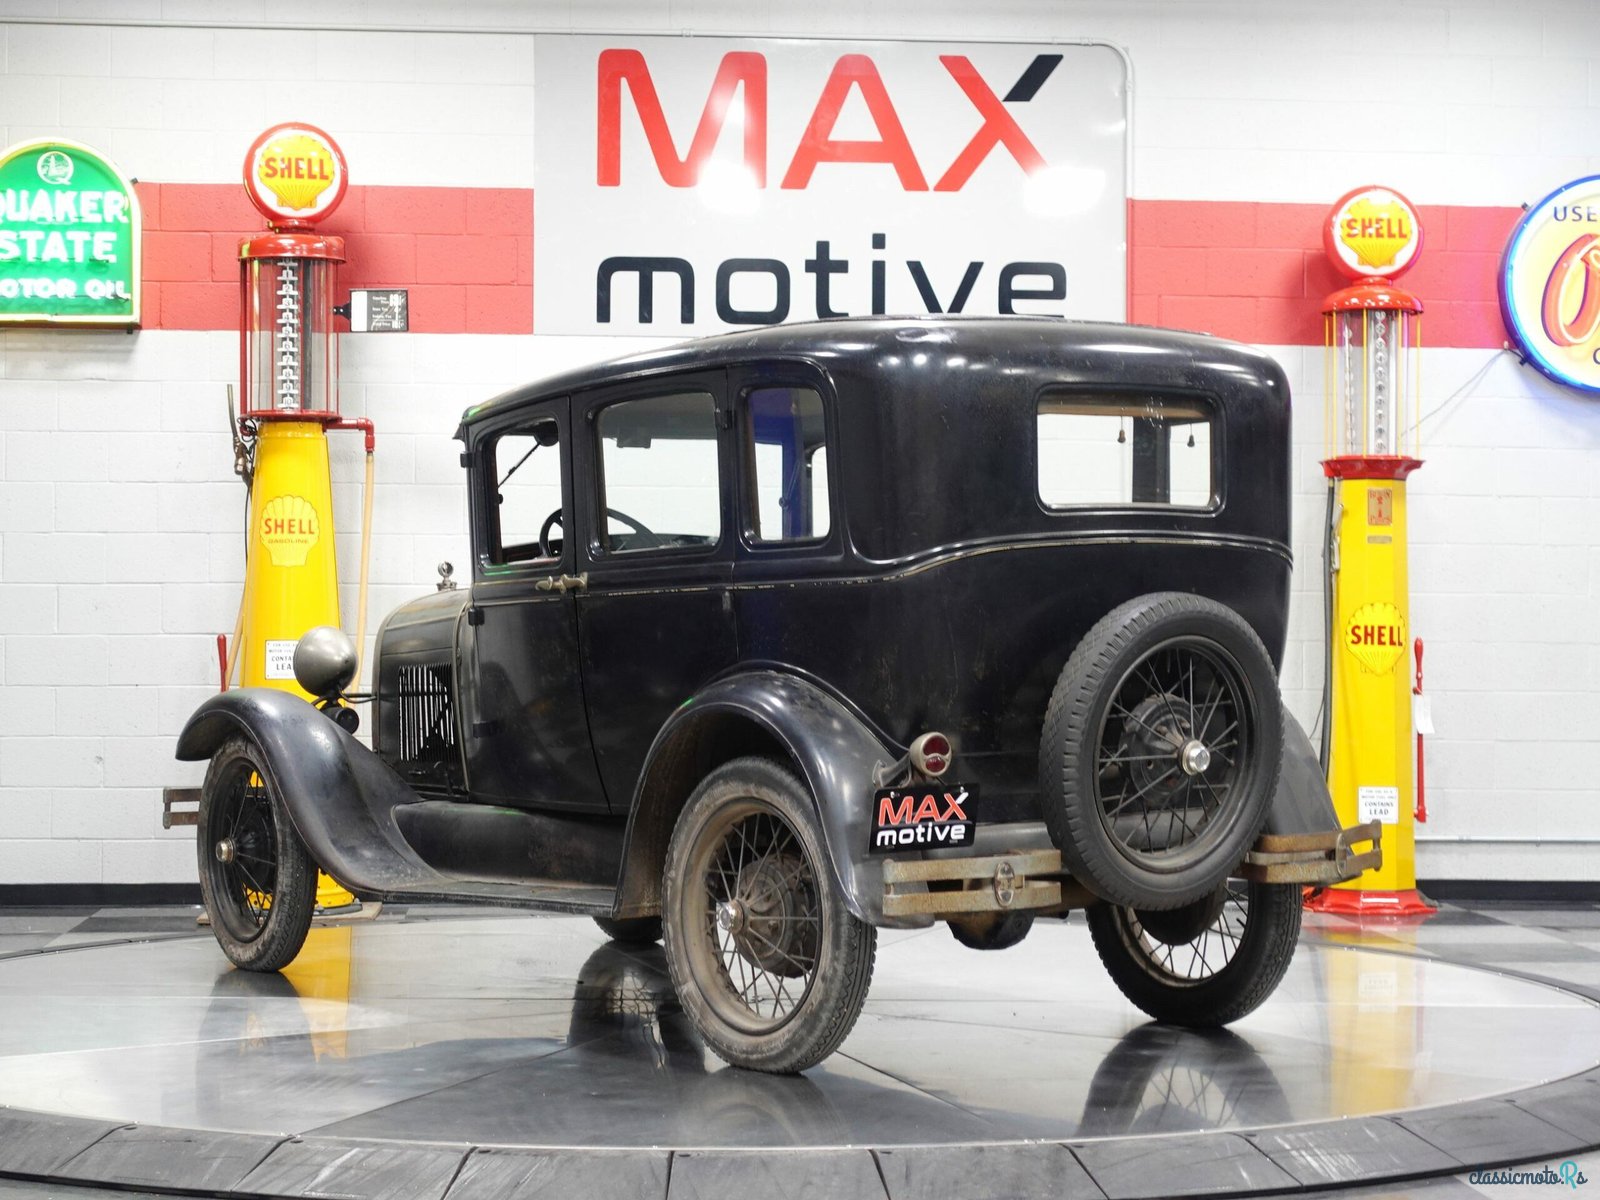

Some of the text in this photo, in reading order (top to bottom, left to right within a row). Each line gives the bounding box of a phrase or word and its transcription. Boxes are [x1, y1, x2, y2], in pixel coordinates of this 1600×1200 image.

[597, 49, 1064, 192] MAX
[264, 157, 330, 180] SHELL
[0, 188, 129, 223] UAKER
[1553, 206, 1598, 222] USE
[1346, 217, 1408, 239] SHELL
[0, 230, 117, 263] STATE
[0, 277, 131, 300] OTOR OIL
[596, 232, 1067, 325] motive
[264, 518, 315, 535] SHELL
[1350, 625, 1404, 647] SHELL
[878, 792, 969, 827] MAX
[1369, 808, 1389, 816] LEAD
[876, 822, 966, 847] motive
